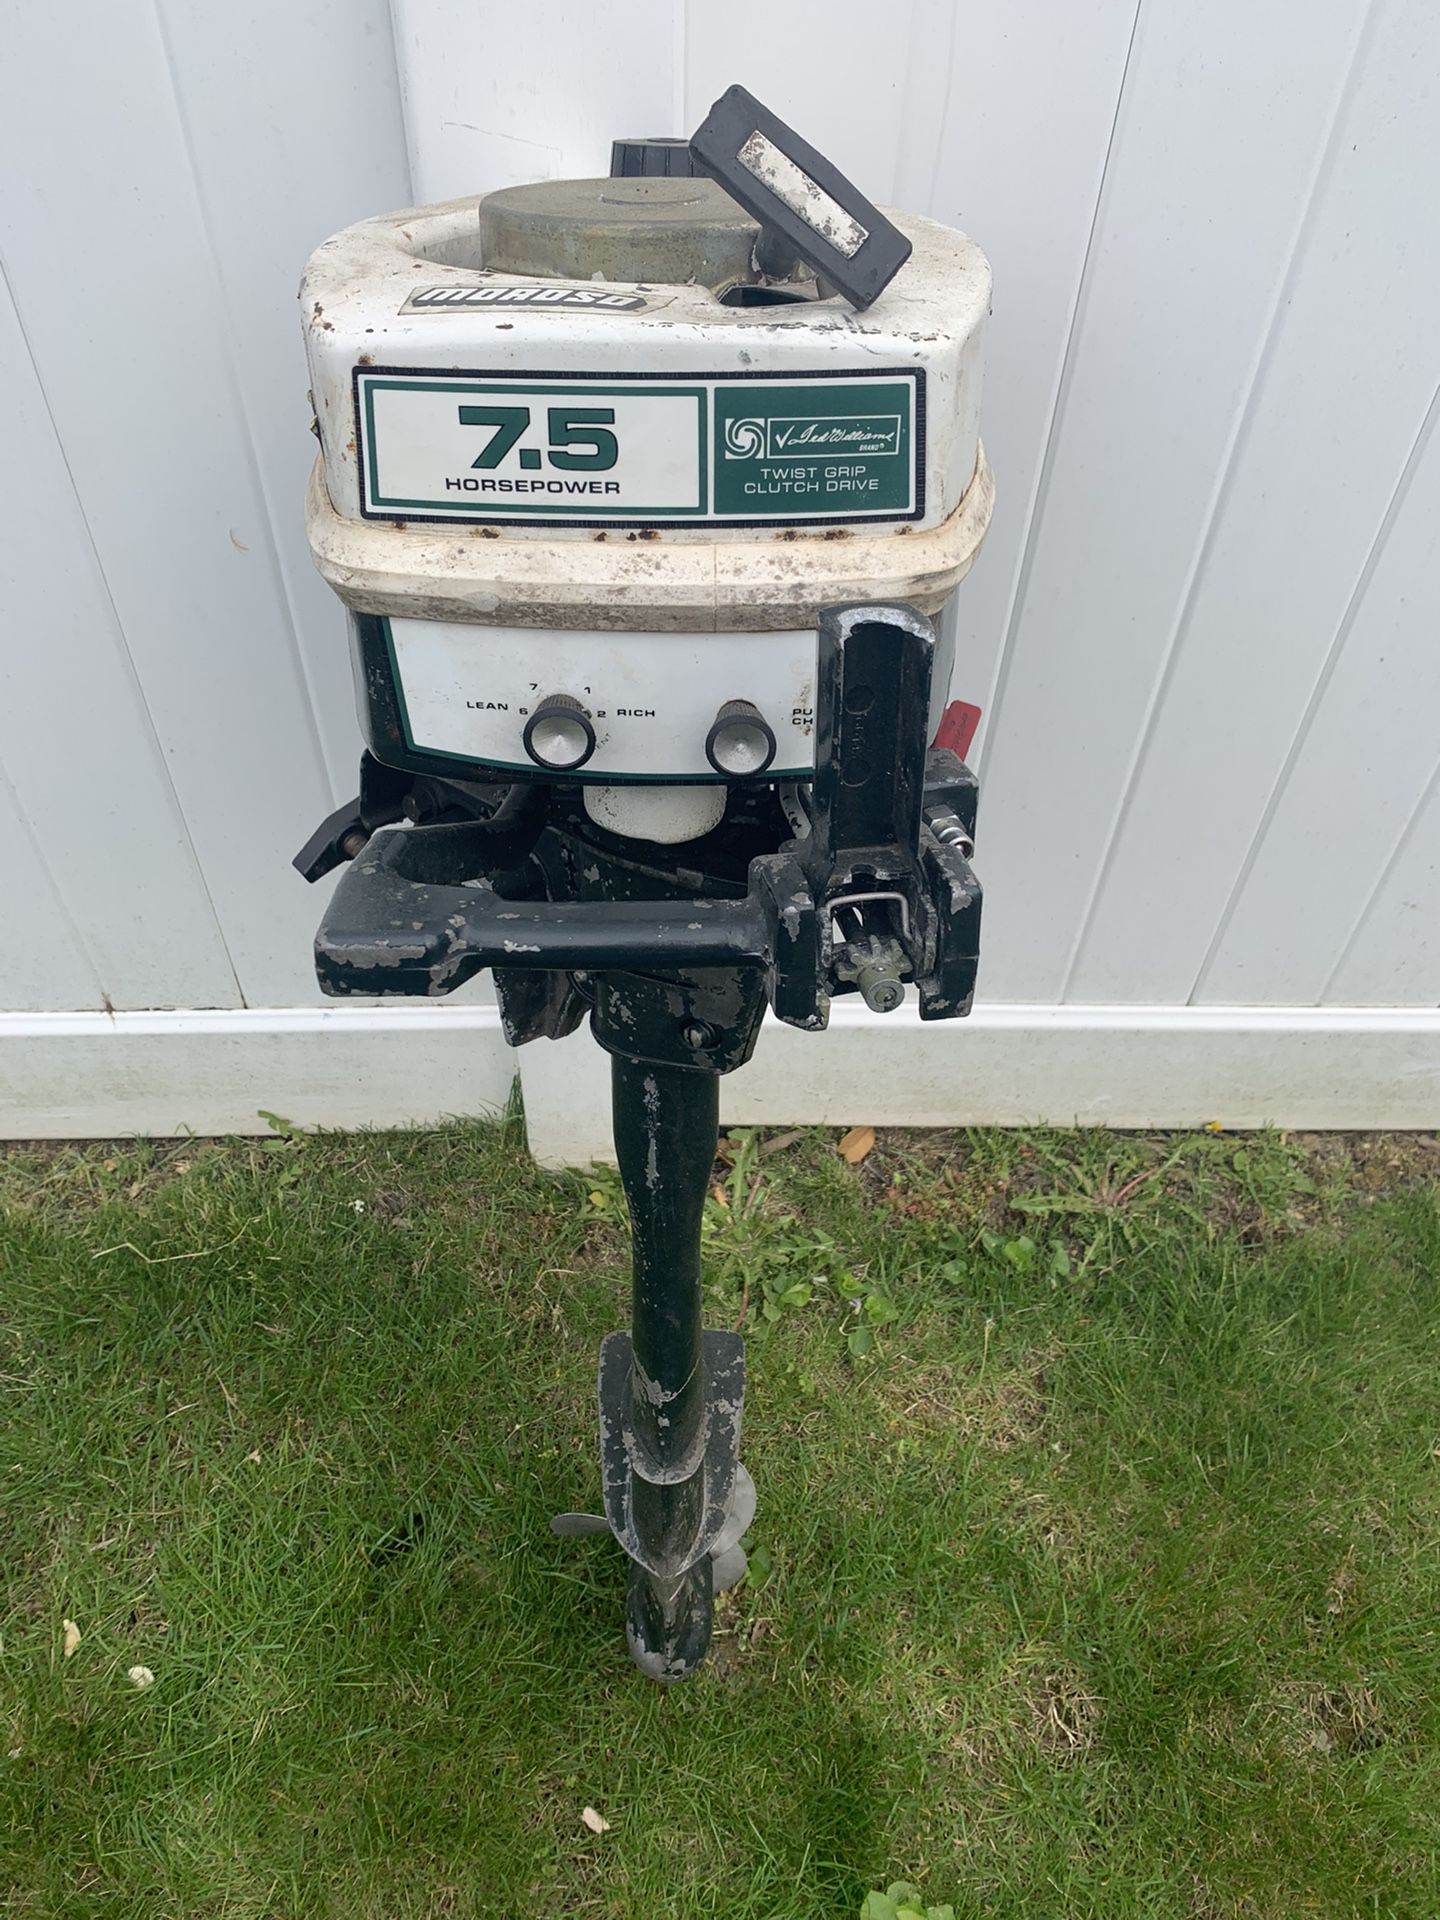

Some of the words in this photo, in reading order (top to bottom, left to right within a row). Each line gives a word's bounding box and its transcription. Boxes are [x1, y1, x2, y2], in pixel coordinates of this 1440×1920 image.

[458, 405, 619, 472] 7.5
[787, 423, 830, 446] Ted
[828, 423, 895, 444] Williams
[760, 467, 818, 480] TWIST
[824, 466, 866, 479] GRIP
[445, 478, 620, 495] HORSEPOWER
[744, 482, 819, 494] CLUTCH
[826, 479, 879, 493] DRIVE
[529, 682, 538, 691] 7
[584, 686, 591, 694] 1
[466, 701, 509, 711] LEAN
[519, 707, 529, 716] 6
[597, 710, 606, 719] 2
[616, 708, 656, 718] RICH
[792, 708, 813, 716] PU
[792, 717, 813, 726] CH
